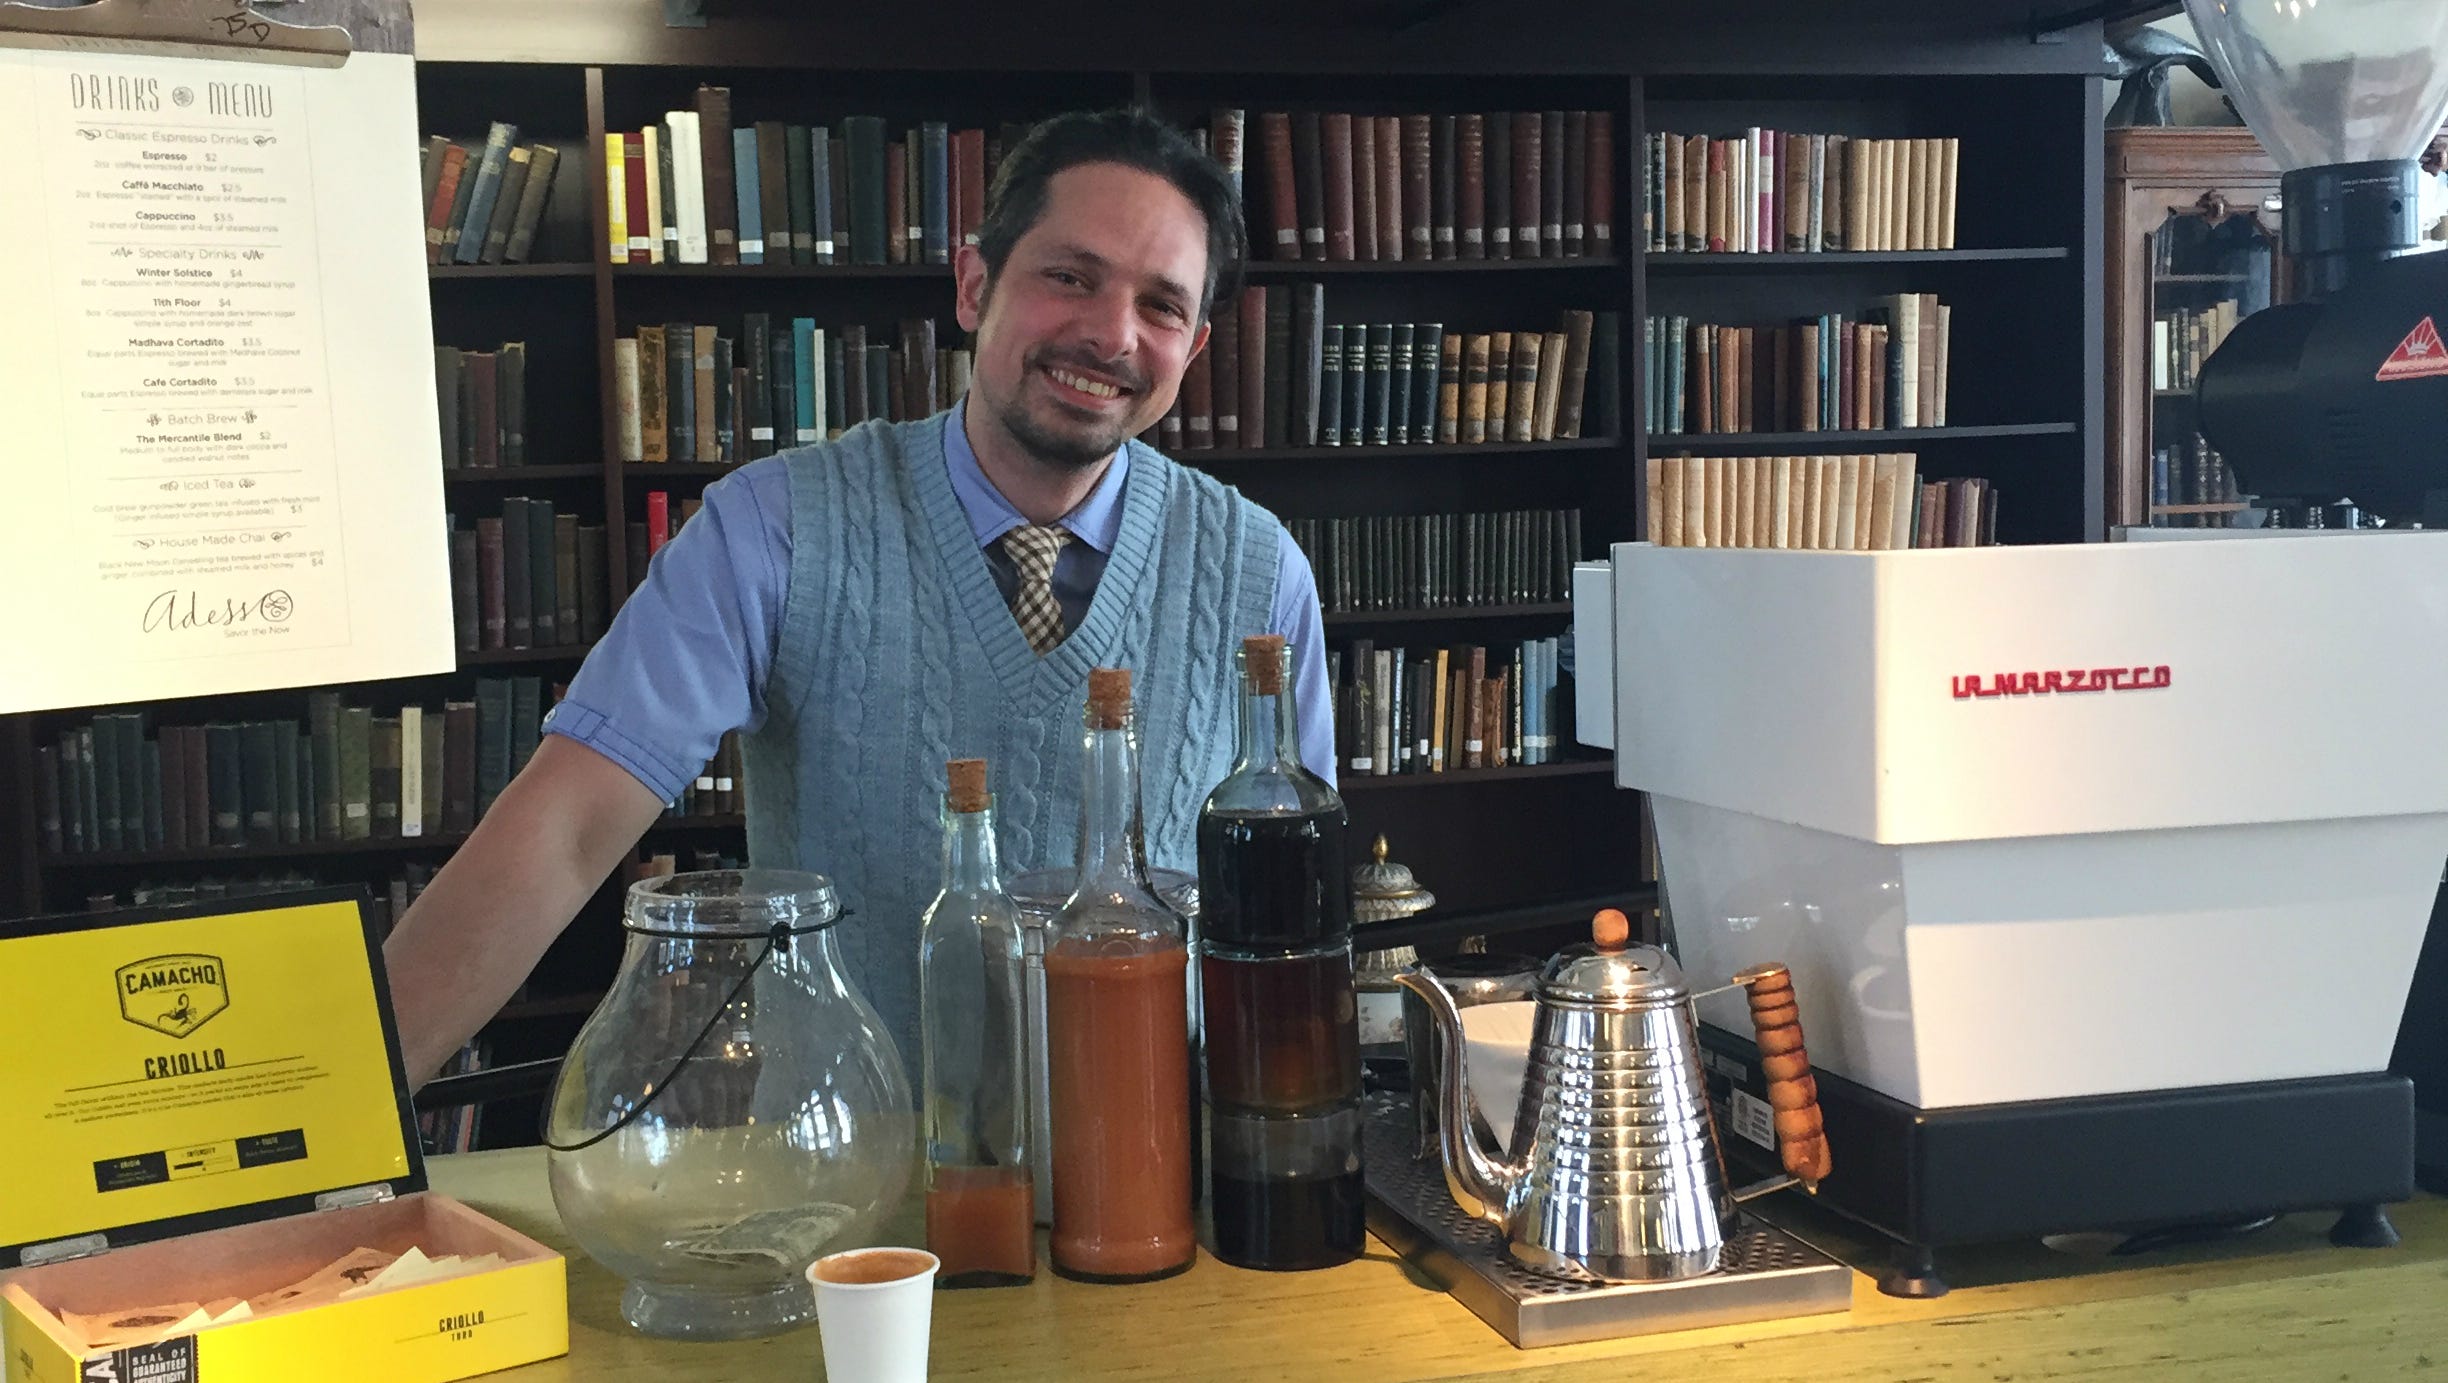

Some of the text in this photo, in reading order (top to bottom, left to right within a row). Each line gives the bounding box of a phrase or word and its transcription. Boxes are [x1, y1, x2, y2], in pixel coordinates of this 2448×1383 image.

[71, 73, 272, 118] DRINKS MENU
[105, 129, 249, 145] Classic Espresso Drinks
[142, 150, 187, 161] Espresso
[152, 181, 204, 192] Macchiato
[135, 210, 196, 221] Cappuccino
[139, 248, 237, 260] Specialty Drinks
[136, 268, 243, 278] Winter Solstice $4
[153, 298, 231, 308] 11th Floor $4
[128, 338, 174, 347] Madhava
[177, 337, 225, 347] Cortadito
[169, 377, 218, 387] Cortadito
[167, 413, 238, 425] Batch Brew
[136, 434, 156, 444] The
[158, 433, 211, 443] Mercantile
[213, 432, 242, 442] Blend
[183, 479, 234, 491] Iced Tea
[159, 532, 266, 548] House Made Chai
[311, 557, 324, 568] $4
[223, 625, 290, 638] Savor the Now
[1994, 666, 2171, 697] MARZOCCO
[126, 964, 216, 995] CAMACHO
[144, 1048, 225, 1079] CRIOLLO
[439, 1310, 485, 1333] CRIOLLO
[132, 1347, 186, 1366] SEAL OF
[133, 1357, 187, 1378] GUARANTEED
